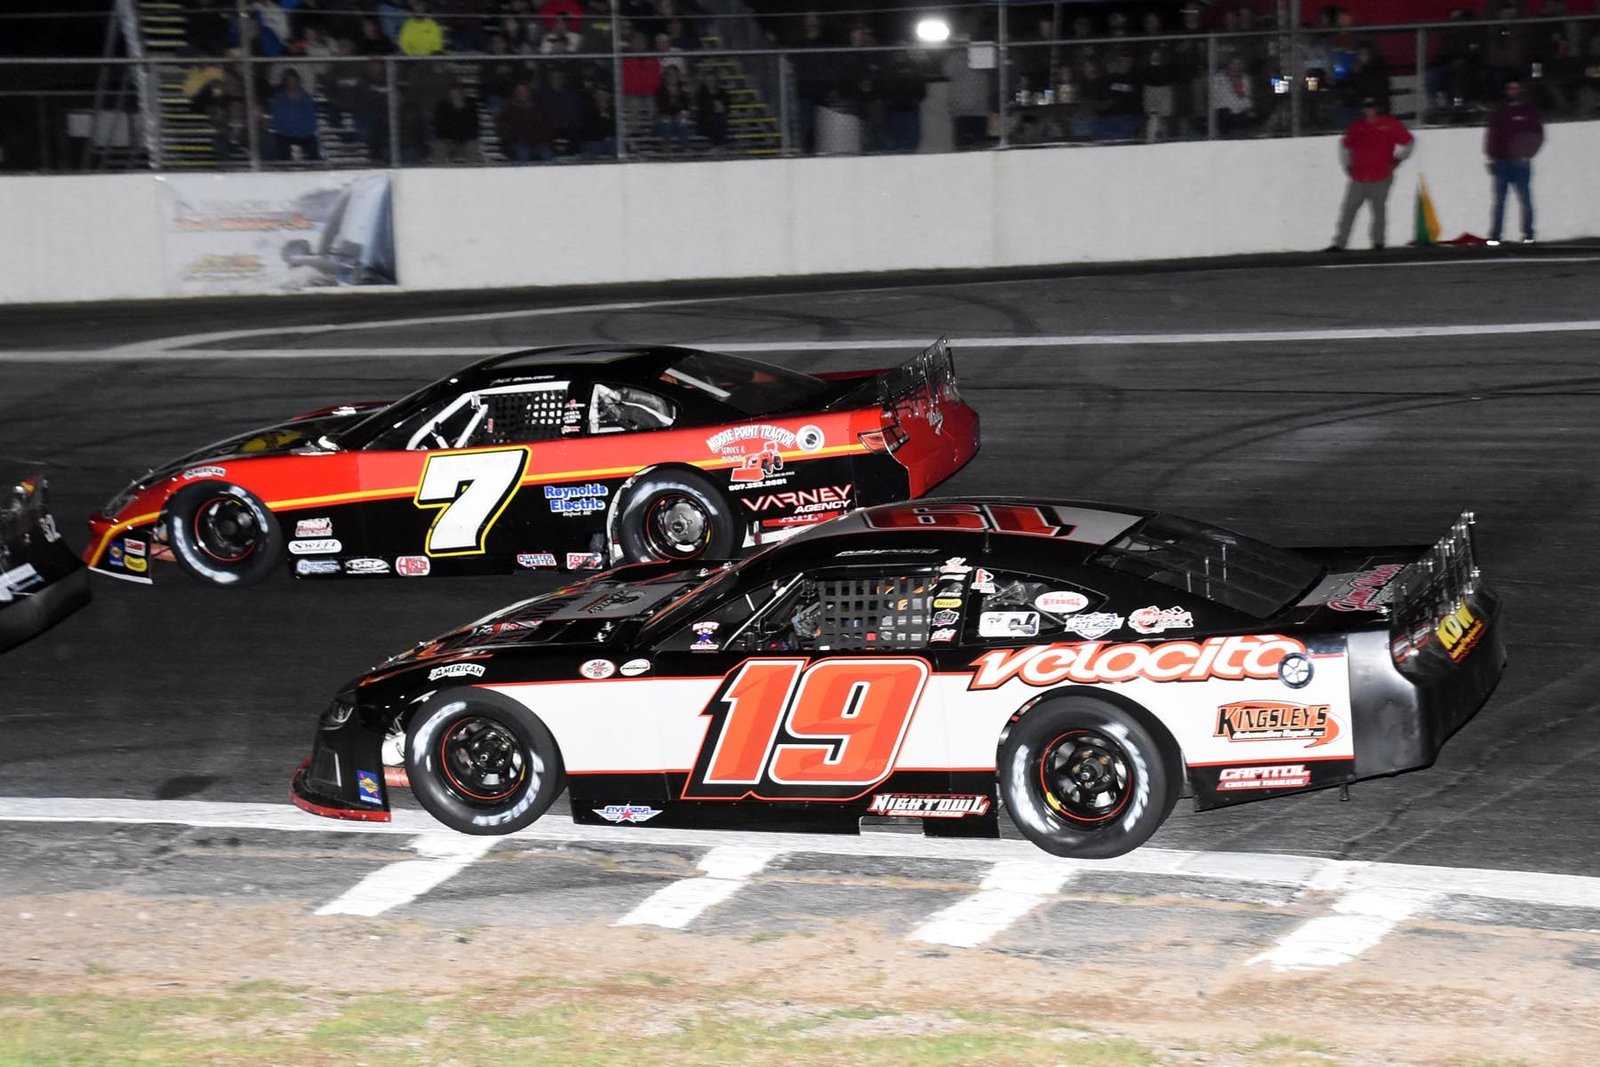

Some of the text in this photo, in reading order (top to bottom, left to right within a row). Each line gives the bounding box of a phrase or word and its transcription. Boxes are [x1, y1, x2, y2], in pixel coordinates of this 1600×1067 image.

[734, 425, 760, 440] POINT
[545, 483, 608, 499] Reynolds
[741, 484, 852, 511] VARNEY
[413, 446, 531, 557] 7
[550, 498, 605, 512] Electric
[794, 500, 851, 513] AGENCY
[433, 665, 484, 679] AMERICAN
[690, 656, 928, 798] 19
[1220, 764, 1312, 780] CAPITOL
